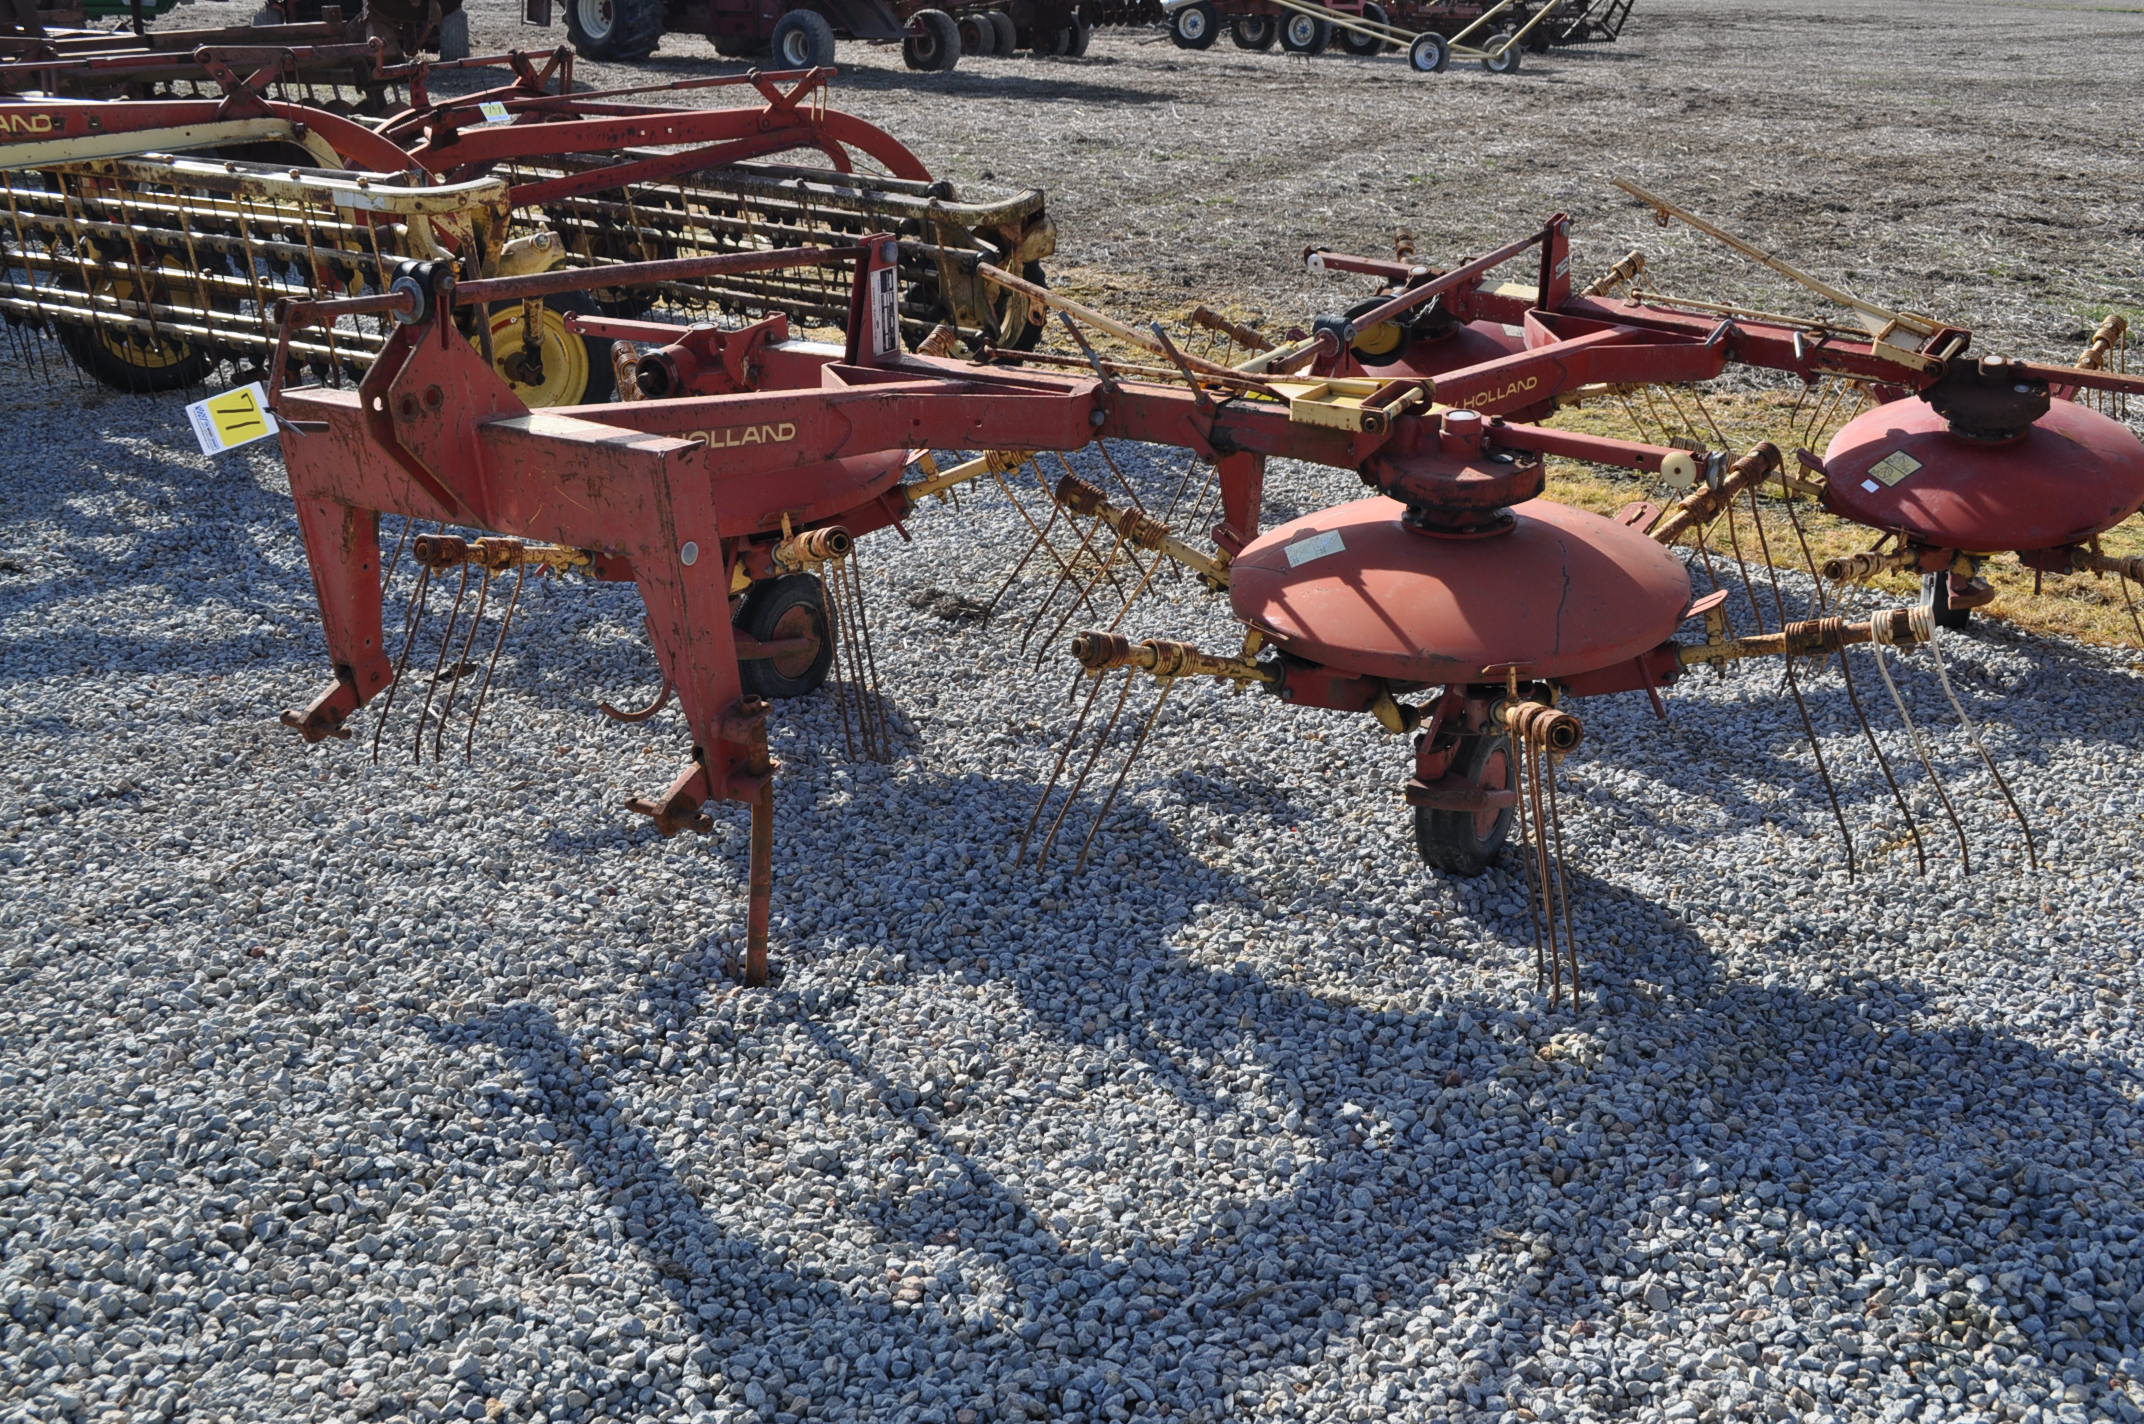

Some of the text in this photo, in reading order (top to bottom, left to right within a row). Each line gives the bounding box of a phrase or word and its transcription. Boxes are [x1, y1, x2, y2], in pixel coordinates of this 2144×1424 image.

[1464, 376, 1538, 409] HOLLAND
[217, 392, 260, 430] 71
[668, 422, 796, 449] OLLAND
